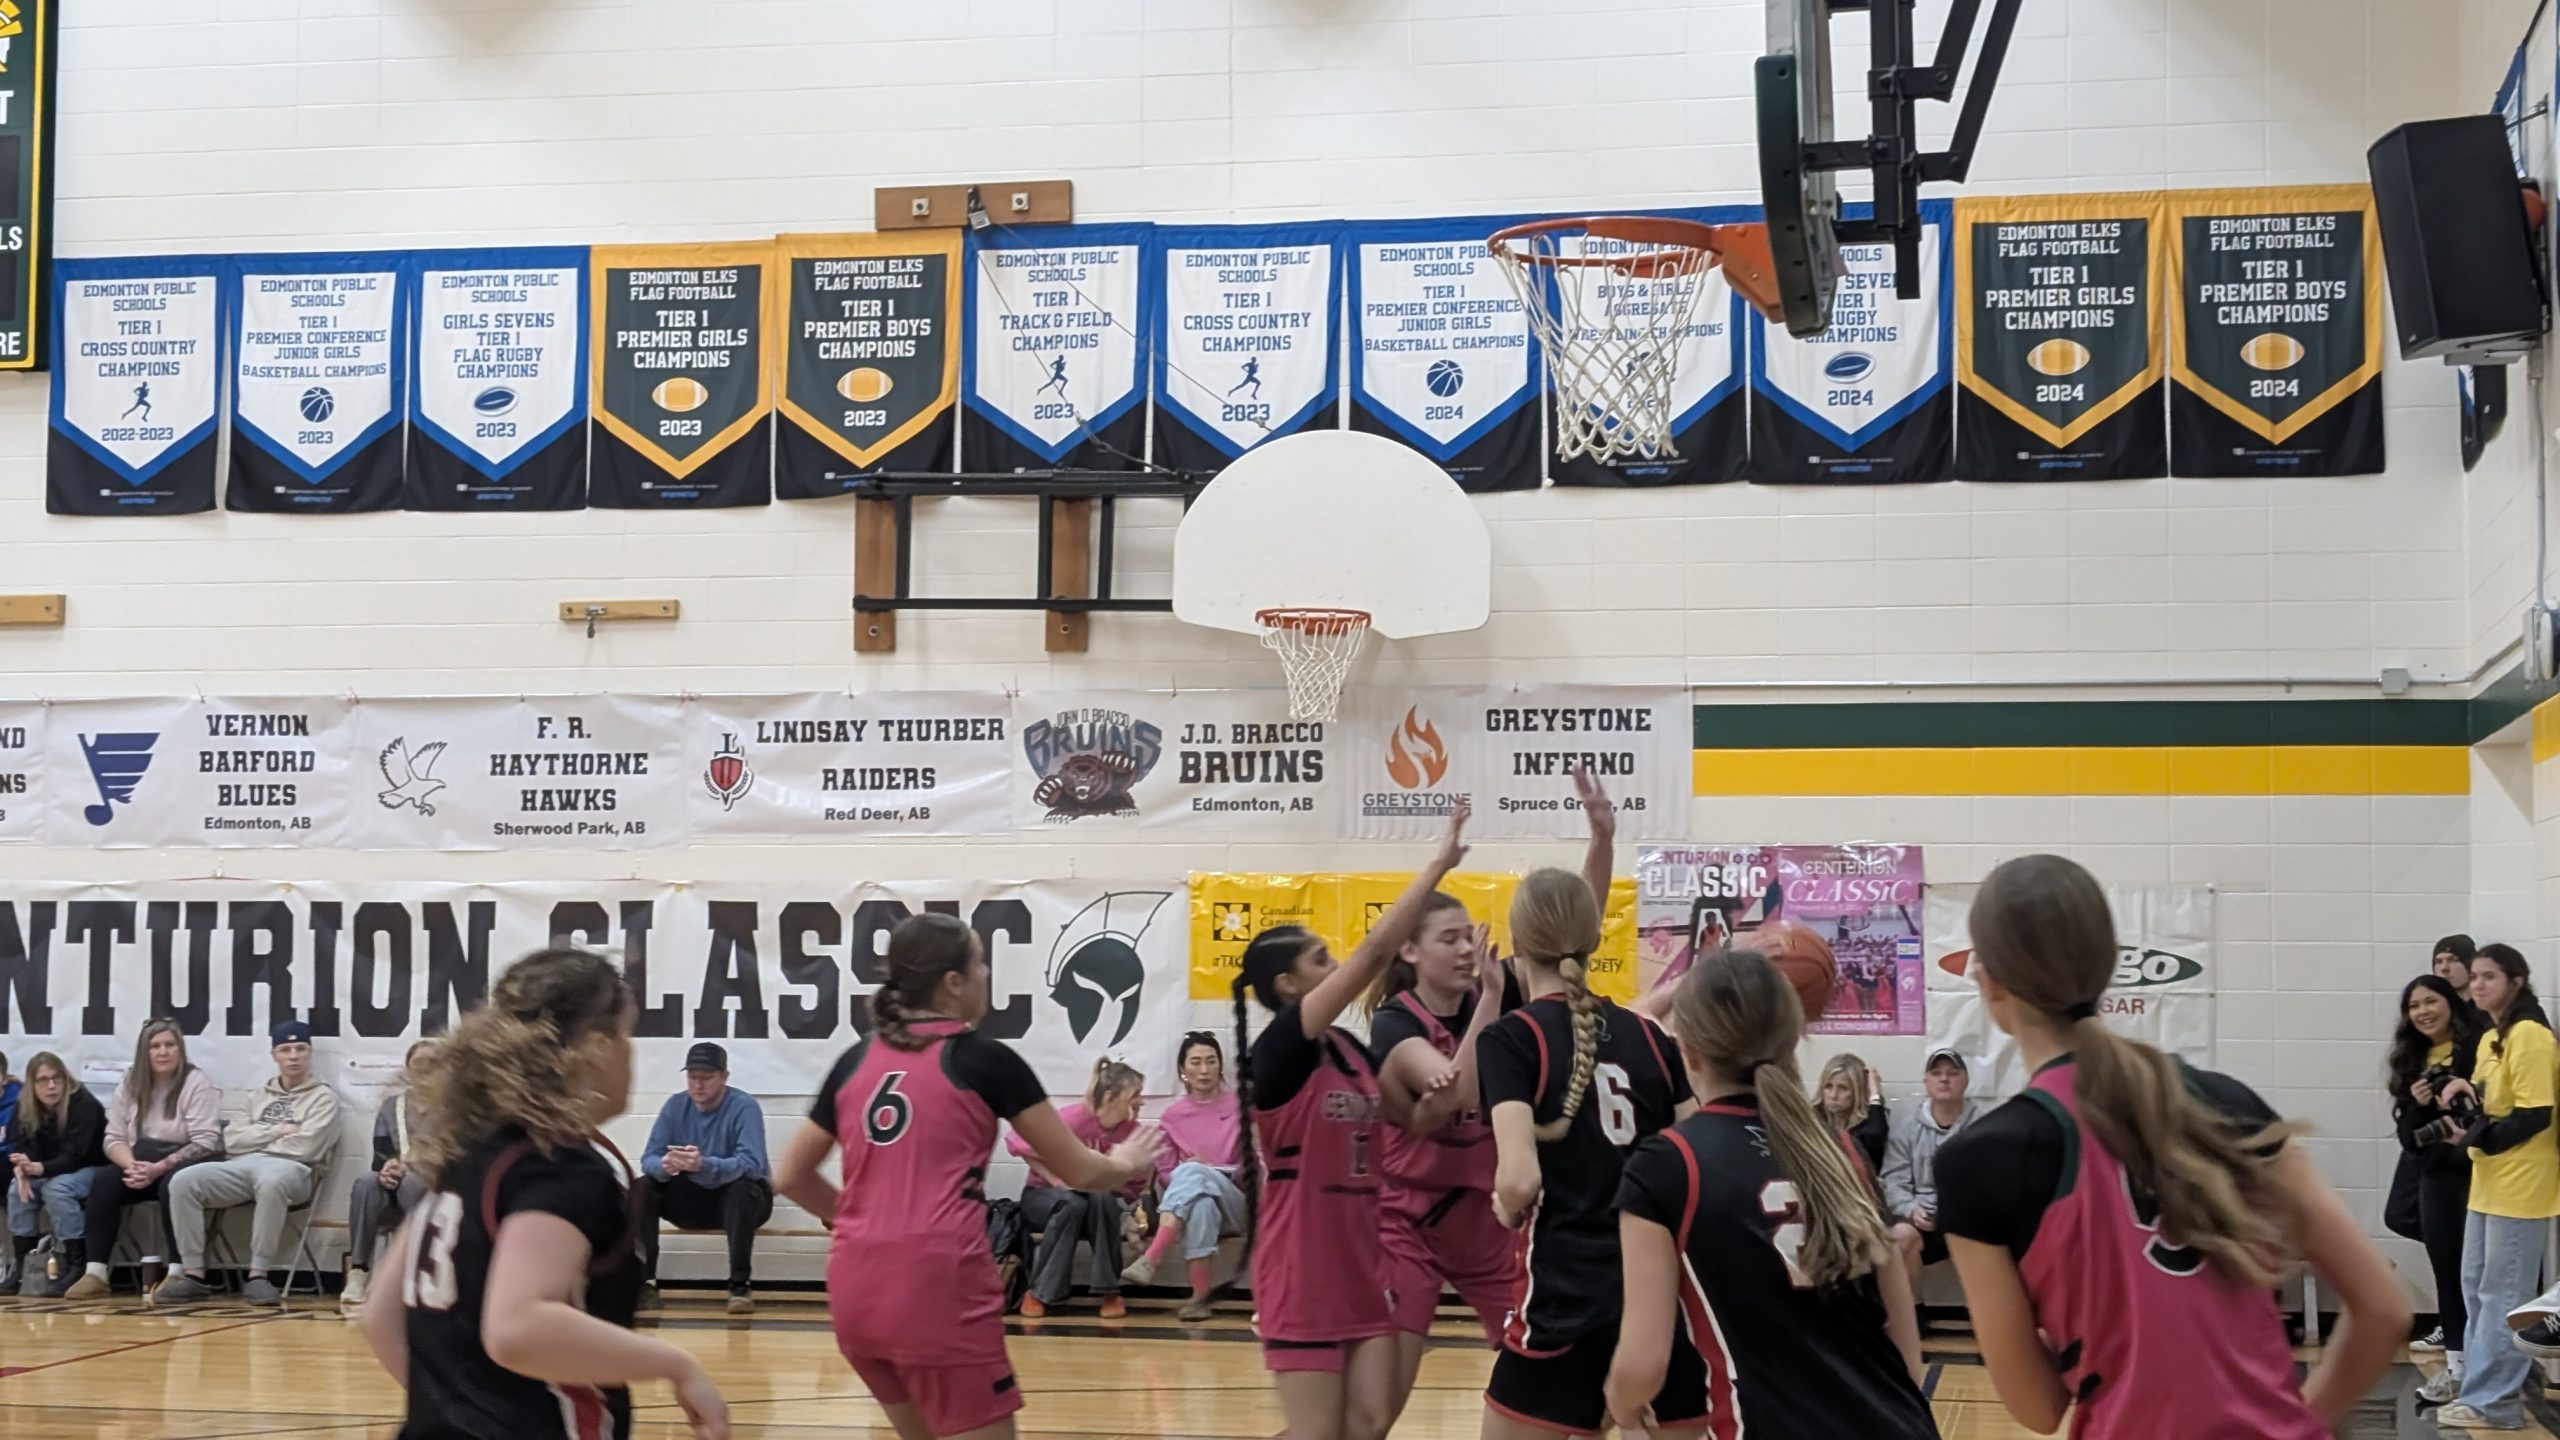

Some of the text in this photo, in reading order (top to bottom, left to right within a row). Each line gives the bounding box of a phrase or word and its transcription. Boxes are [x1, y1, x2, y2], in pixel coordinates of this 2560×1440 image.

[1998, 223, 2120, 240] EDMONTON ELKS
[2210, 216, 2335, 234] EDMONTON ELKS
[2000, 240, 2119, 257] FLAG FOOTBALL
[2211, 233, 2334, 251] FLAG FOOTBALL
[997, 251, 1118, 267] EDMONTON PUBLIC
[1186, 251, 1310, 267] EDMONTON PUBLIC
[1380, 247, 1453, 261] EDMONTON
[814, 259, 923, 275] EDMONTON ELKS
[1414, 262, 1474, 277] SCHOOLS
[2242, 260, 2303, 279] TIER 1
[442, 274, 558, 288] EDMONTON PUBLIC
[630, 270, 737, 285] EDMONTON ELKS
[815, 275, 922, 290] FLAG FOOTBALL
[1028, 269, 1086, 282] SCHOOLS
[1219, 269, 1277, 283] SCHOOLS
[2030, 266, 2088, 285] TIER 1
[84, 282, 196, 297] EDMONTON PUBLIC
[261, 278, 376, 292] EDMONTON PUBLIC
[631, 286, 736, 300] FLAG FOOTBALL
[1423, 285, 1465, 299] TIER 1
[2201, 281, 2346, 303] PREMIER BOYS
[113, 298, 166, 311] SCHOOLS
[291, 294, 345, 307] SCHOOLS
[472, 290, 527, 303] SCHOOLS
[1033, 291, 1080, 307] TIER 1
[1224, 292, 1271, 308] TIER 1
[1871, 293, 1875, 307] 1
[1986, 287, 2134, 307] PREMIER GIRLS
[842, 300, 893, 317] TIER 1
[1367, 301, 1521, 316] PREMIER CONFERENCE
[2218, 304, 2328, 324] CHAMPIONS
[299, 316, 337, 328] TIER 1
[444, 313, 554, 329] GIRLS SEVENS
[656, 310, 708, 327] TIER 1
[1001, 313, 1112, 329] TRACK & FIELD
[1184, 312, 1311, 330] CROSS COUNTRY
[1398, 316, 1491, 332] JUNIOR GIRLS
[2006, 309, 2113, 329] CHAMPIONS
[118, 320, 161, 335] TIER 1
[805, 319, 931, 338] PREMIER BOYS
[247, 330, 386, 344] PREMIER CONFERENCE
[477, 332, 520, 346] TIER 1
[617, 329, 747, 348] PREMIER GIRLS
[1013, 334, 1098, 351] CHAMPIONS
[1203, 335, 1291, 352] CHAMPIONS
[1365, 335, 1524, 351] BASKETBALL CHAMPIONS
[81, 340, 196, 356] CROSS COUNTRY
[274, 346, 360, 359] JUNIOR GIRLS
[454, 348, 543, 363] FLAG RUGBY
[819, 340, 915, 359] CHAMPIONS
[634, 350, 729, 368] CHAMPIONS
[99, 362, 179, 377] CHAMPIONS
[242, 363, 386, 378] BASKETBALL CHAMPIONS
[458, 364, 538, 378] CHAMPIONS
[2037, 384, 2083, 402] 2024
[2251, 379, 2298, 397] 2024
[1828, 390, 1873, 406] 2024
[845, 410, 886, 426] 2023
[1035, 402, 1075, 419] 2023
[1222, 404, 1270, 421] 2023
[1426, 406, 1463, 420] 2024
[102, 427, 173, 441] 2022-2023
[477, 423, 516, 437] 2023
[660, 420, 701, 435] 2023
[299, 431, 333, 444] 2023
[206, 715, 309, 736] VERNON
[538, 717, 591, 738] F. R.
[1487, 709, 1651, 731] GREYSTONE
[757, 719, 1004, 743] LINDSAY THURBER
[1181, 722, 1322, 744] J.D. BRACCO
[1024, 719, 1162, 783] BRUINS
[200, 751, 314, 772] BARFORD
[490, 753, 648, 776] HAYTHORNE
[1180, 750, 1323, 783] BRUINS
[823, 768, 935, 790] RAIDERS
[218, 784, 296, 806] BLUES
[521, 789, 616, 811] HAWKS
[1193, 798, 1313, 813] Edmonton, AB
[1499, 797, 1645, 813] Spruce AB
[825, 807, 930, 823] Red Deer, AB
[205, 817, 311, 831] Edmonton, AB
[494, 822, 645, 836] Sherwood Park, AB
[1803, 861, 1897, 876] CENTURION
[1646, 866, 1767, 898] CLASSIC
[1260, 905, 1314, 916] Canadian
[863, 1071, 912, 1145] 6
[1593, 1062, 1637, 1147] 6
